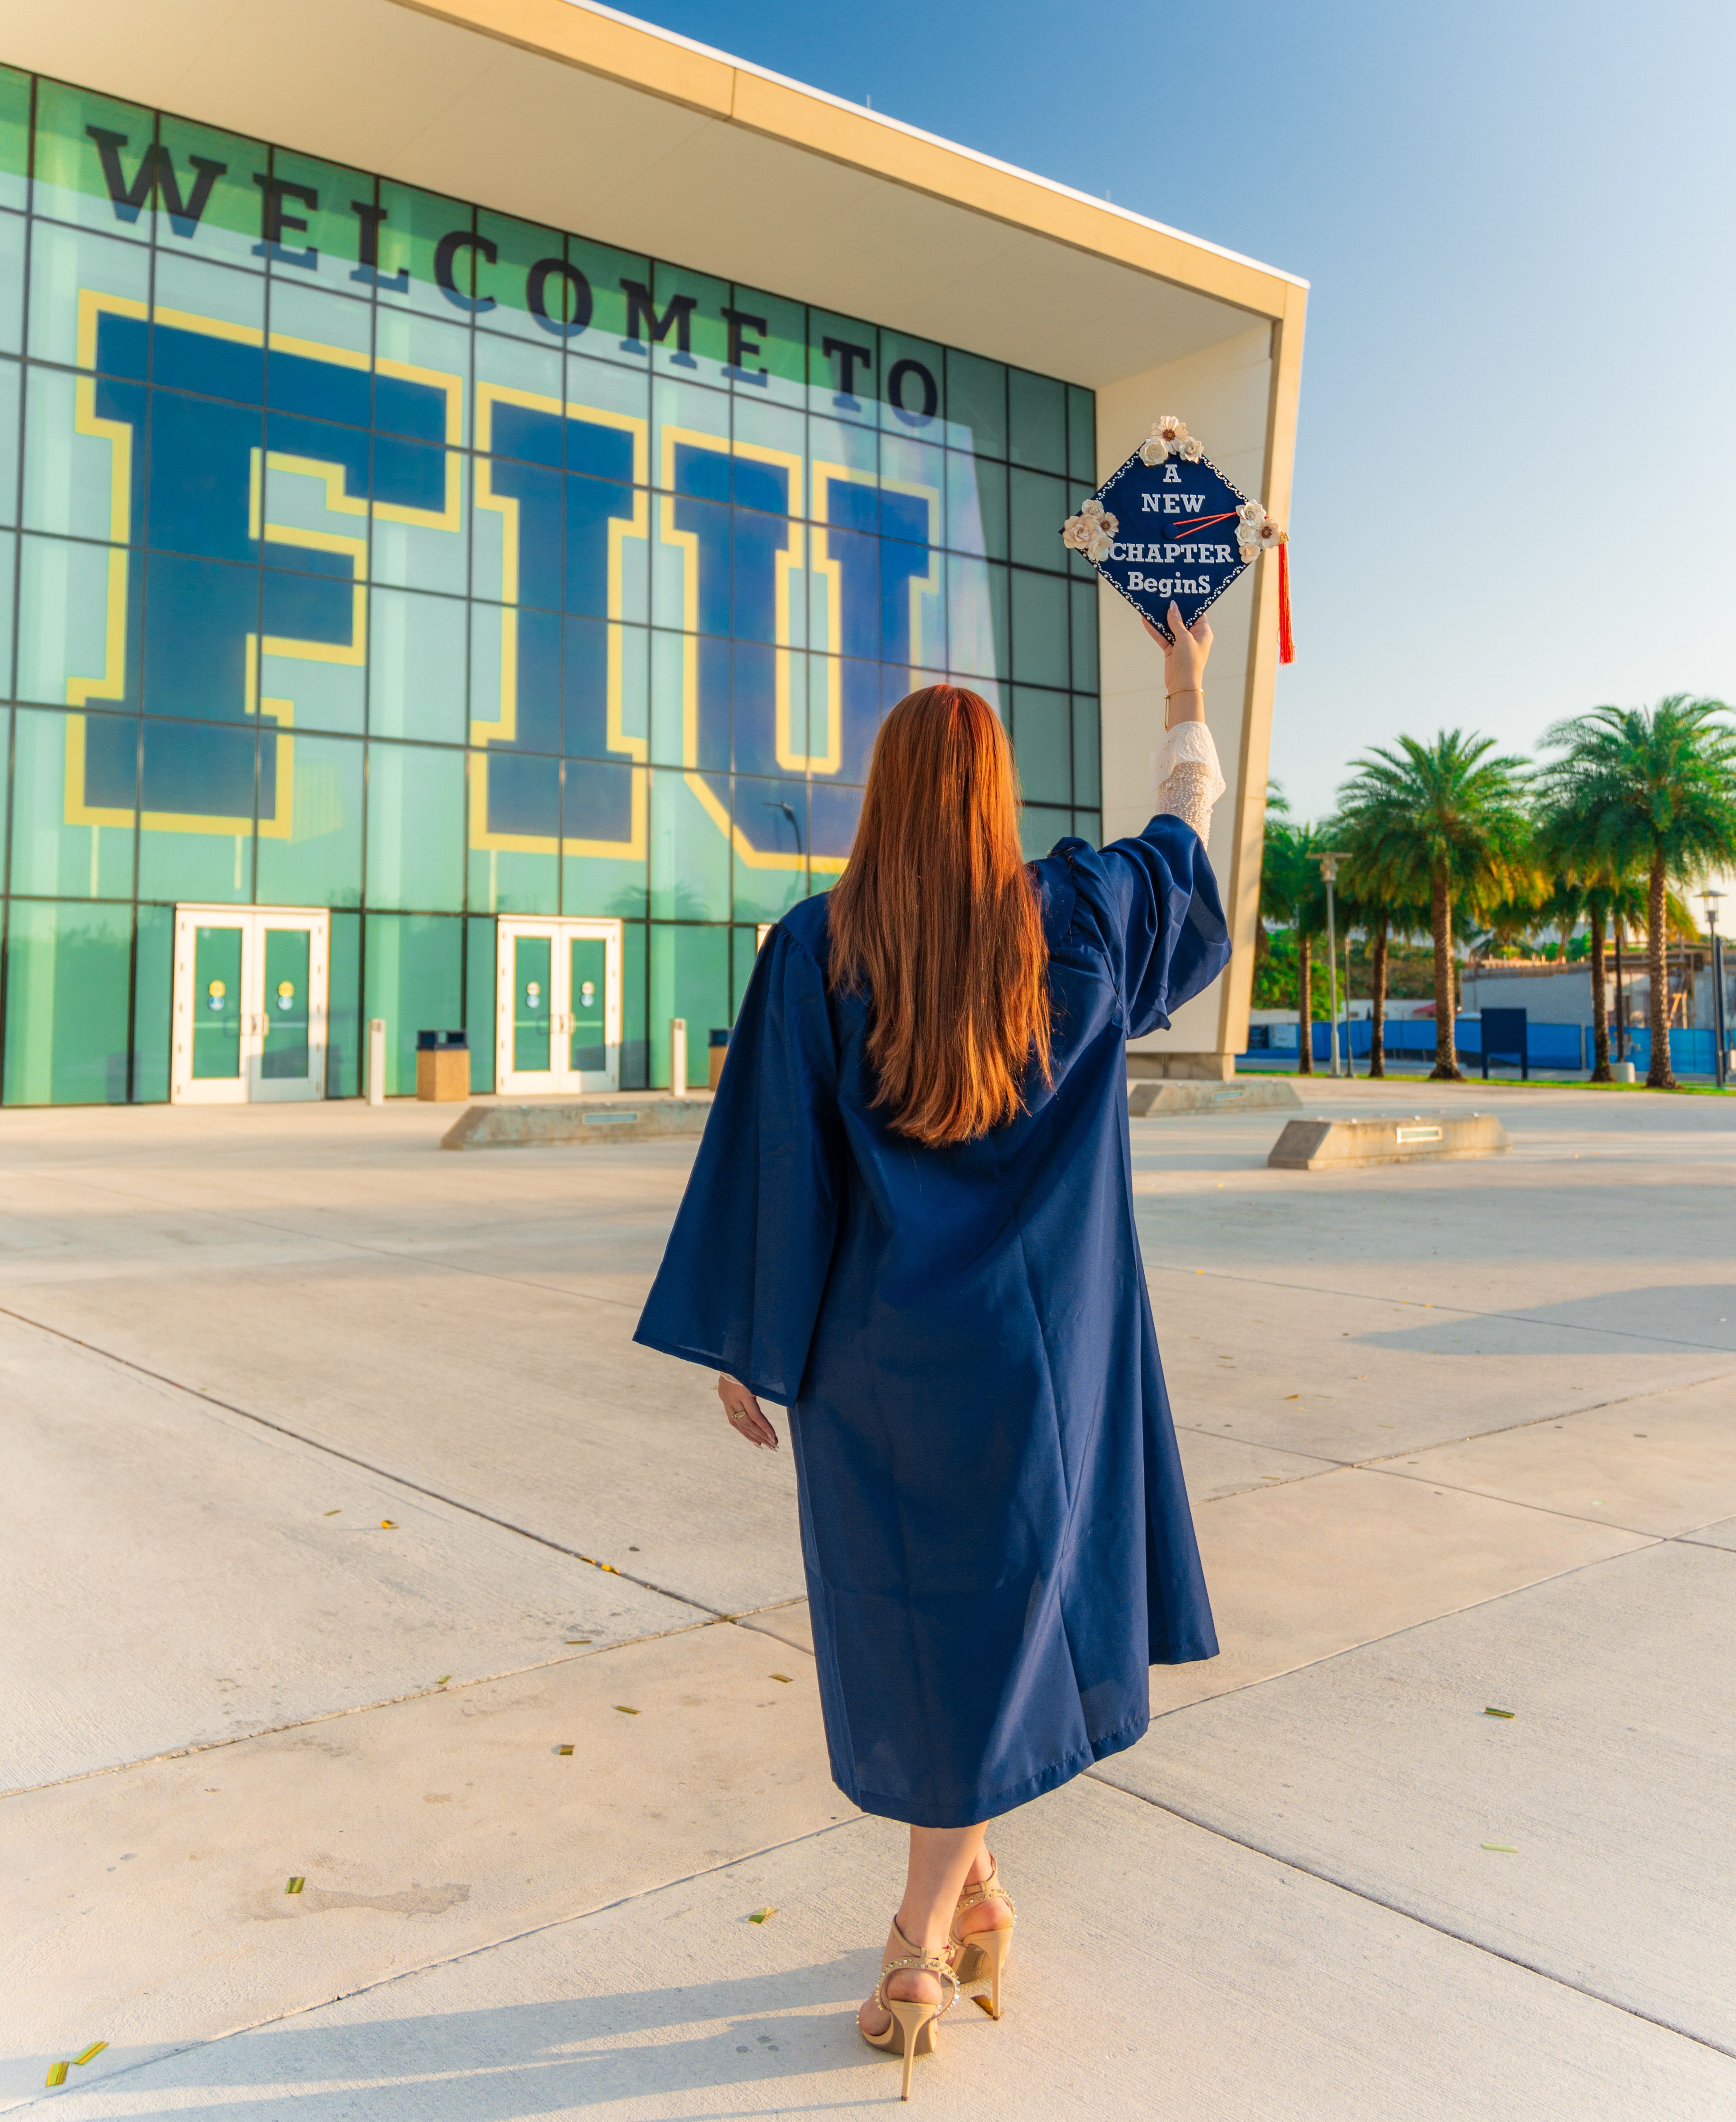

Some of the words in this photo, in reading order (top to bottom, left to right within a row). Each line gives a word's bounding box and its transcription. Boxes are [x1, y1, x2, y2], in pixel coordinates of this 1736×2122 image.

[86, 125, 768, 387] WELCOME
[822, 336, 938, 428] TO
[1163, 464, 1182, 483] A
[1141, 493, 1206, 513] NEW
[1109, 542, 1234, 563] CHAPTER
[64, 289, 939, 872] FIU
